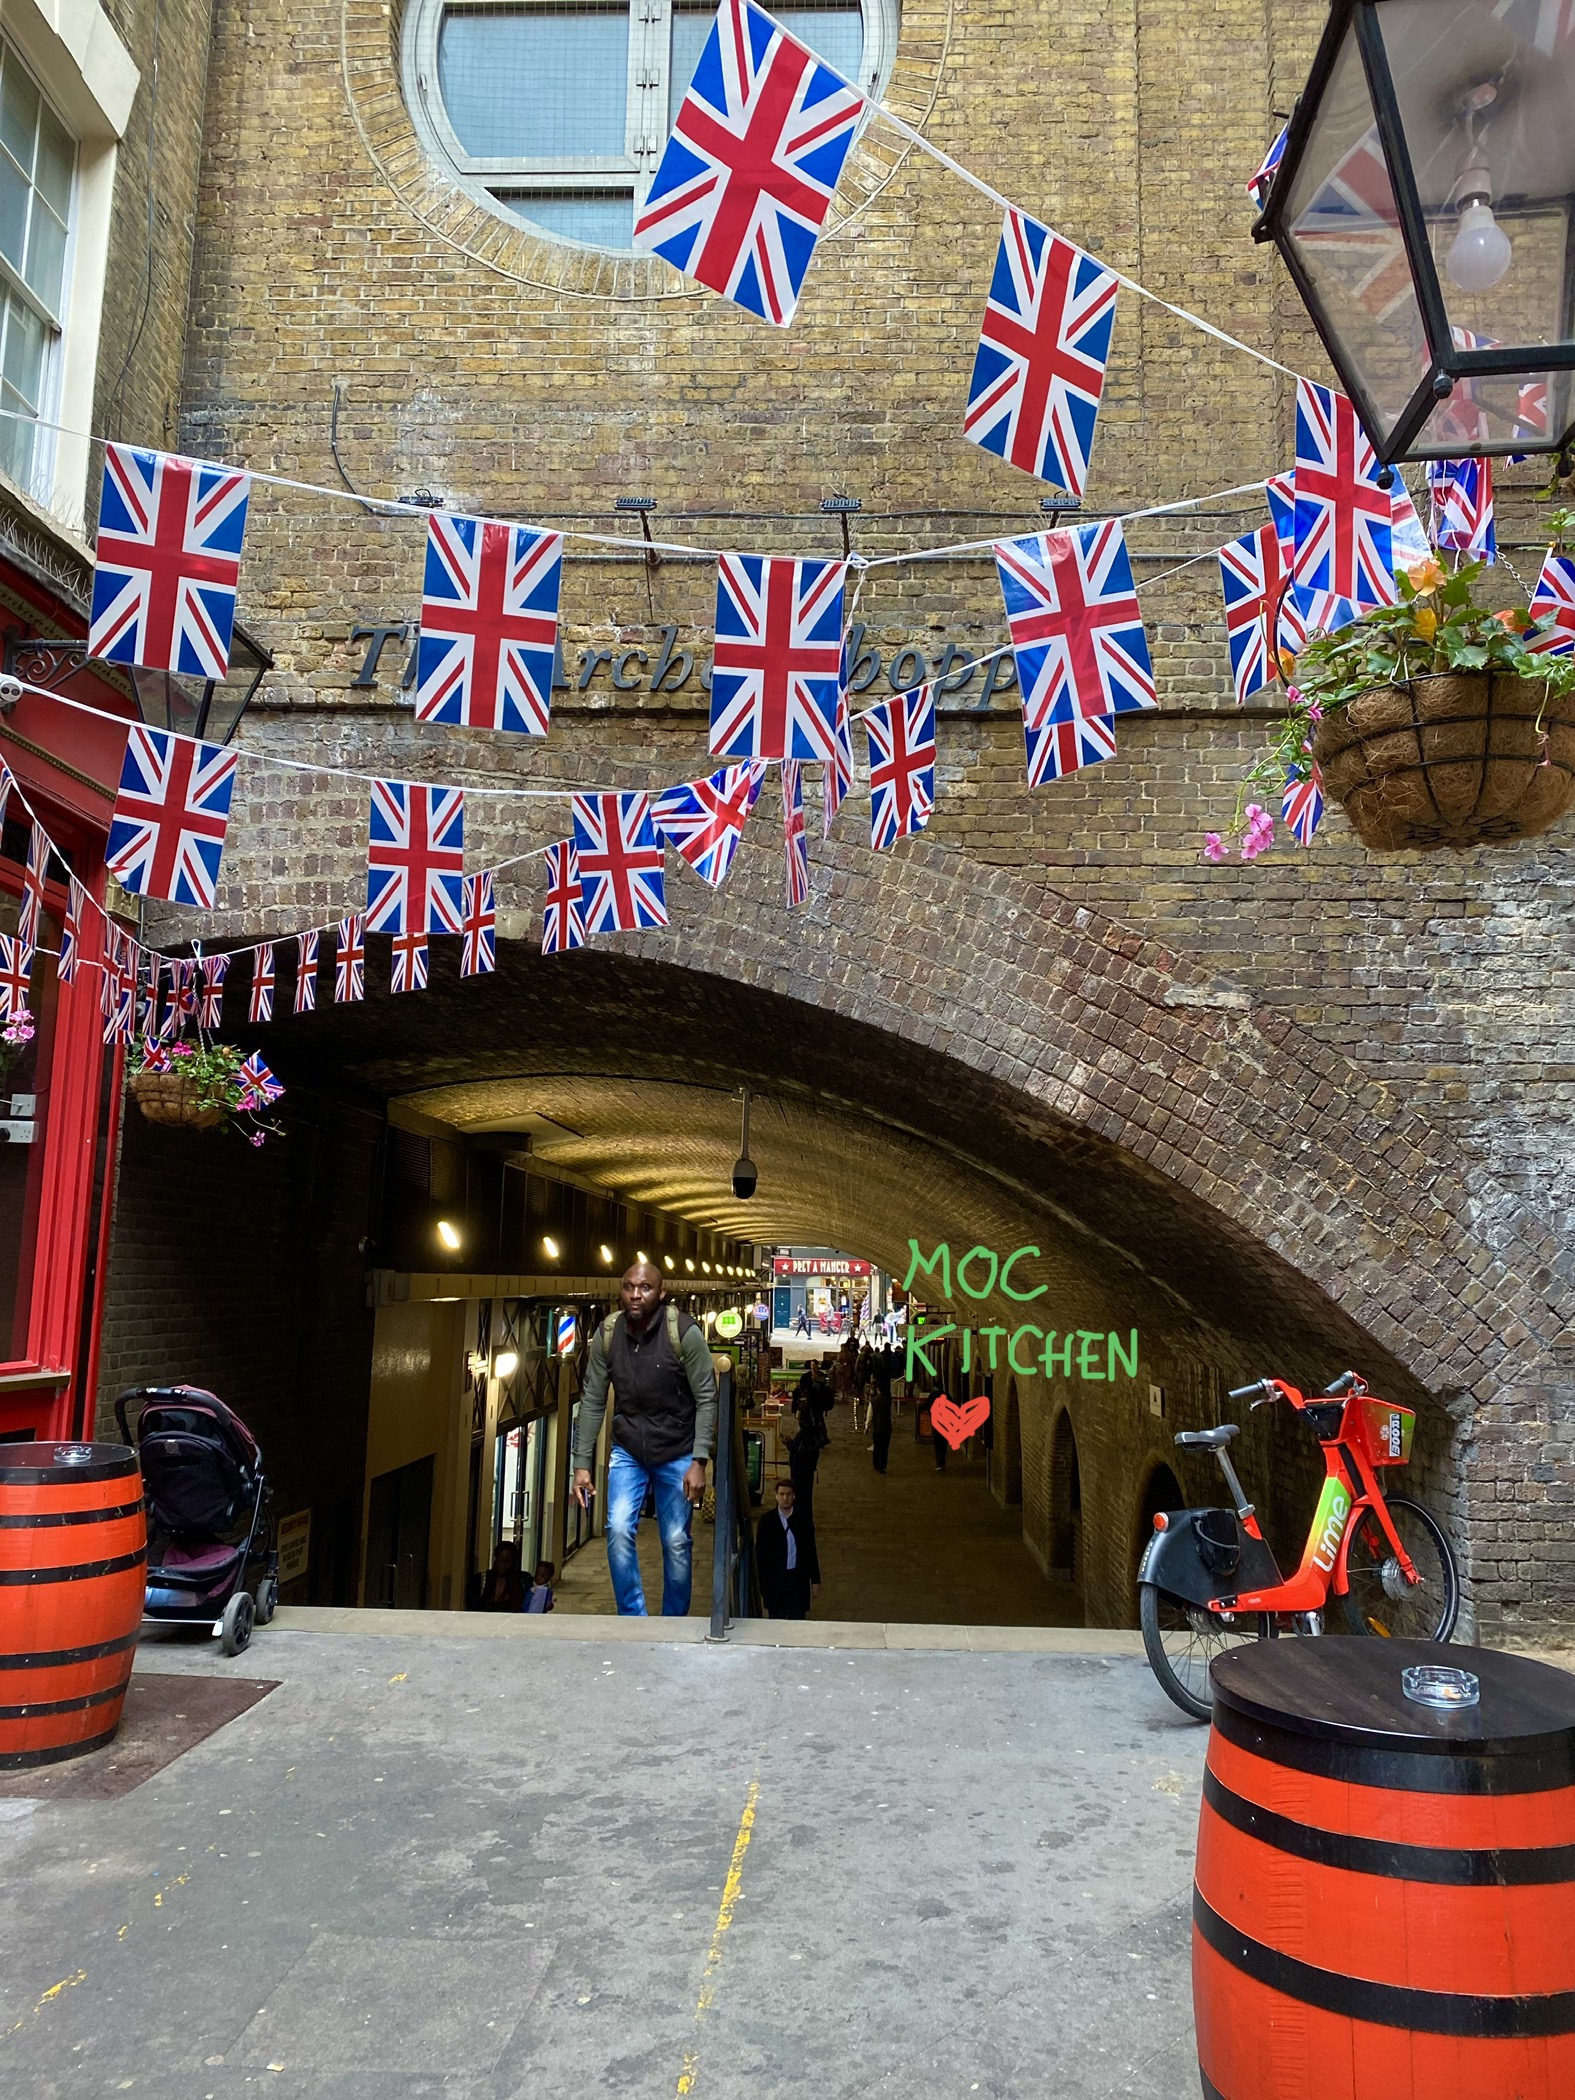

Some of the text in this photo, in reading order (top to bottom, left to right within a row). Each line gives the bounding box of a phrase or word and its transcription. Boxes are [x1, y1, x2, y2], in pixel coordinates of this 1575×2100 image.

[792, 1260, 850, 1274] PRET A MANGER
